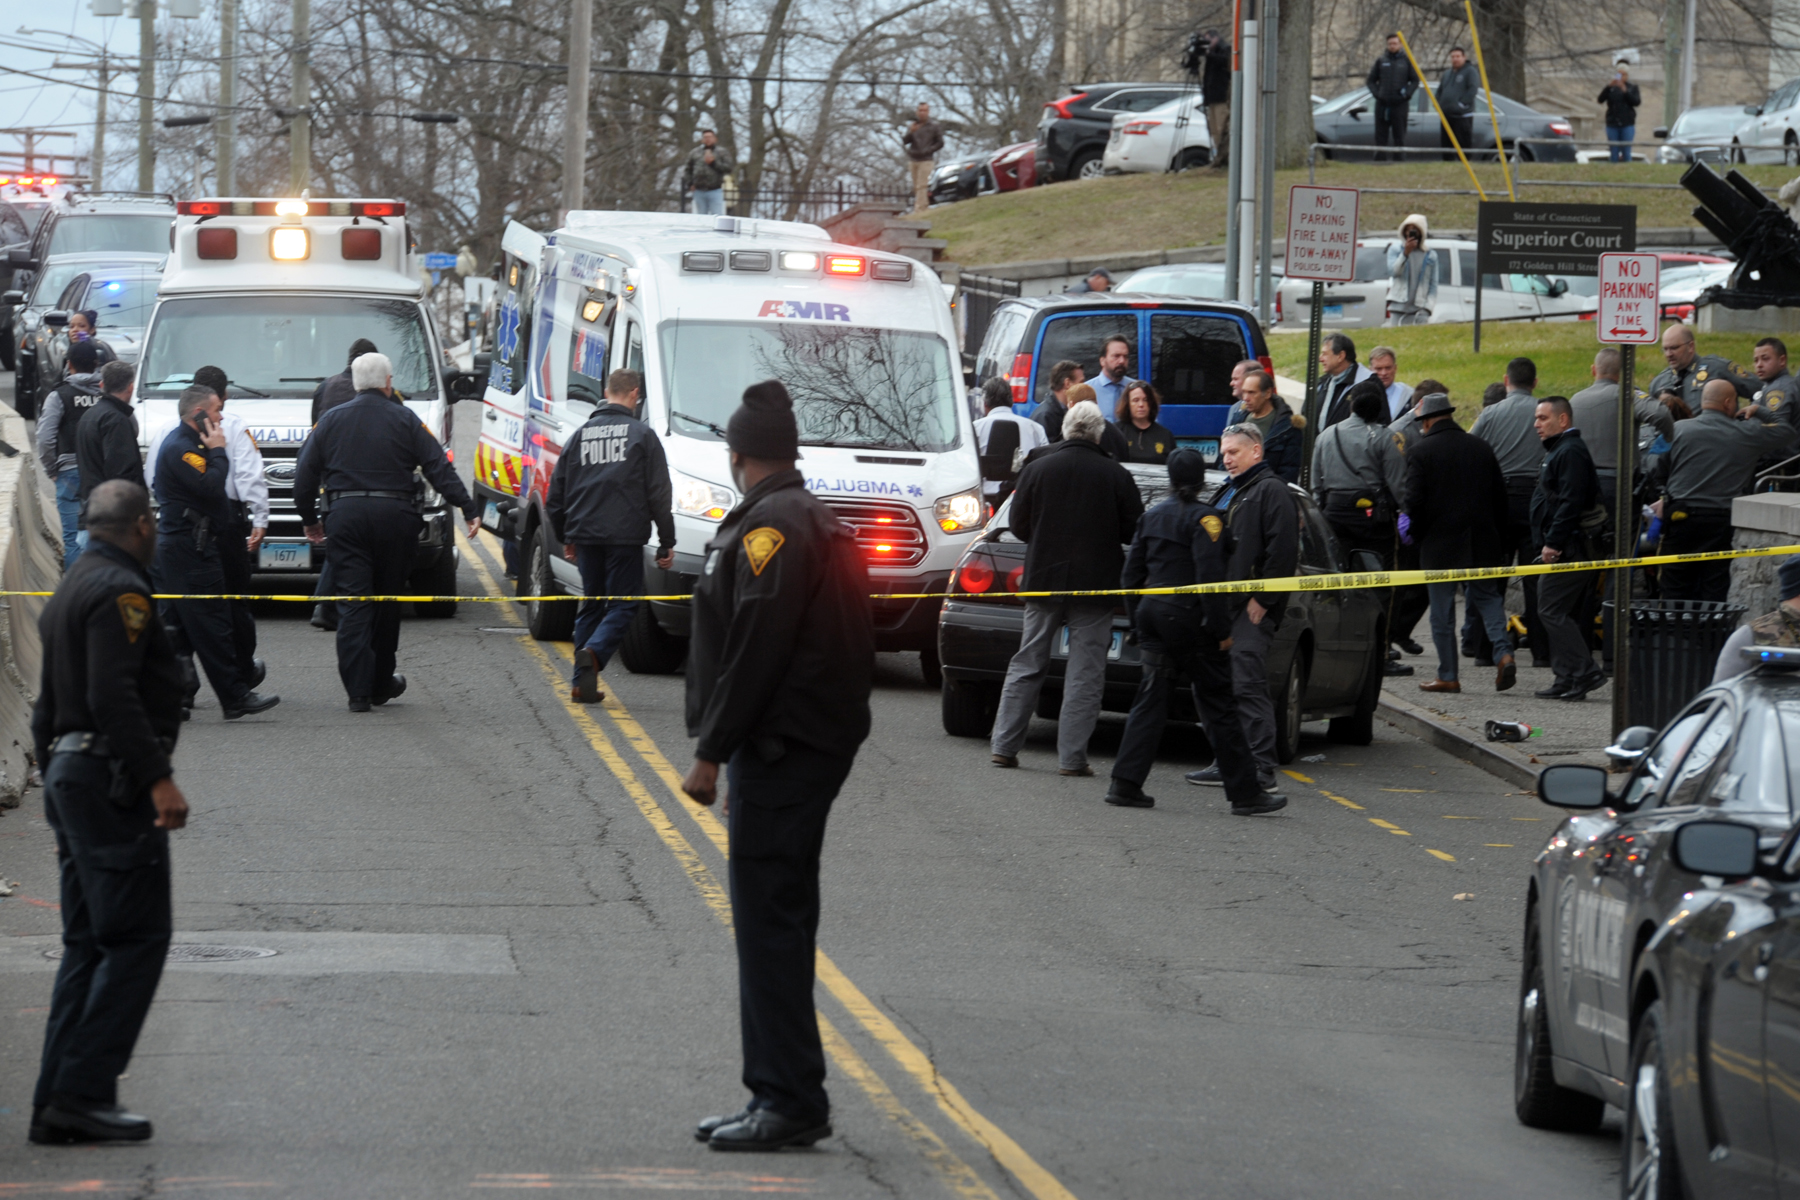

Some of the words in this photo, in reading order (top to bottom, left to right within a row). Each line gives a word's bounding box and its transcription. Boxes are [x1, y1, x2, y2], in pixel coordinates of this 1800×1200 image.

[1316, 195, 1332, 208] NO
[1300, 213, 1346, 226] PARKING
[1513, 212, 1534, 221] State
[1537, 212, 1547, 222] of
[1549, 213, 1601, 223] Connecticut
[1293, 229, 1316, 242] FIRE
[1321, 231, 1350, 244] LANE
[1491, 229, 1568, 250] Superior
[1570, 231, 1623, 248] Court
[1294, 246, 1348, 260] TOW-AWAY
[1293, 262, 1320, 272] POLICE
[1508, 261, 1521, 270] 172
[1523, 261, 1554, 270] Golden
[1557, 262, 1575, 271] Hill
[1577, 263, 1598, 272] Stree
[1618, 260, 1640, 277] NO
[1603, 282, 1655, 299] PARKING
[757, 300, 852, 322] AMR
[1616, 301, 1641, 312] ANY
[1614, 315, 1642, 326] TIME
[74, 395, 103, 408] POLI
[503, 418, 520, 444] 712
[581, 424, 630, 441] BRIDGEPORT
[580, 438, 629, 467] POLICE
[274, 550, 297, 562] 1677
